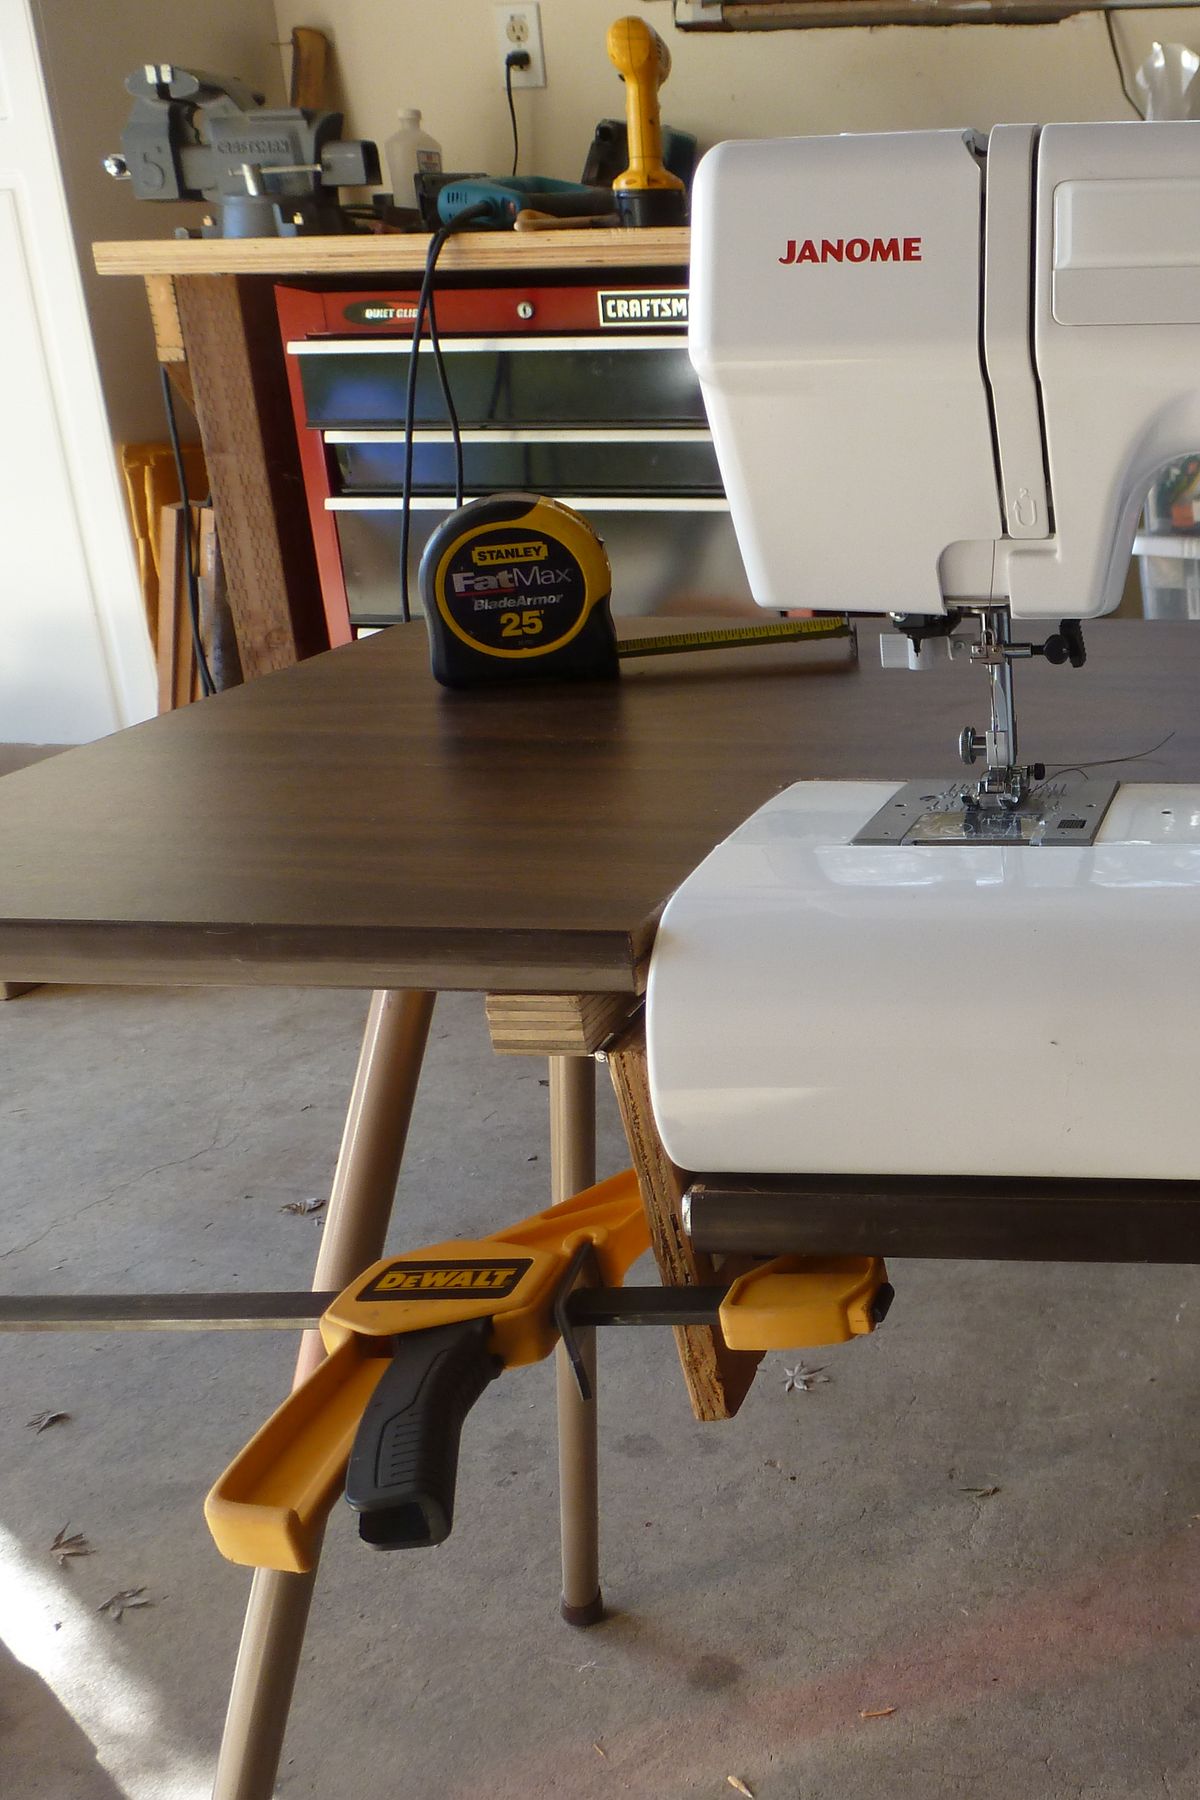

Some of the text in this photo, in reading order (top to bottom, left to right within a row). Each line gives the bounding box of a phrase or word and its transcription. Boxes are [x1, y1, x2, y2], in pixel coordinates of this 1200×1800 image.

[778, 237, 923, 265] JANOME
[365, 308, 394, 319] QUIET
[477, 546, 542, 561] STANLEY
[452, 565, 572, 593] FatMax
[473, 593, 563, 611] BladeArmor
